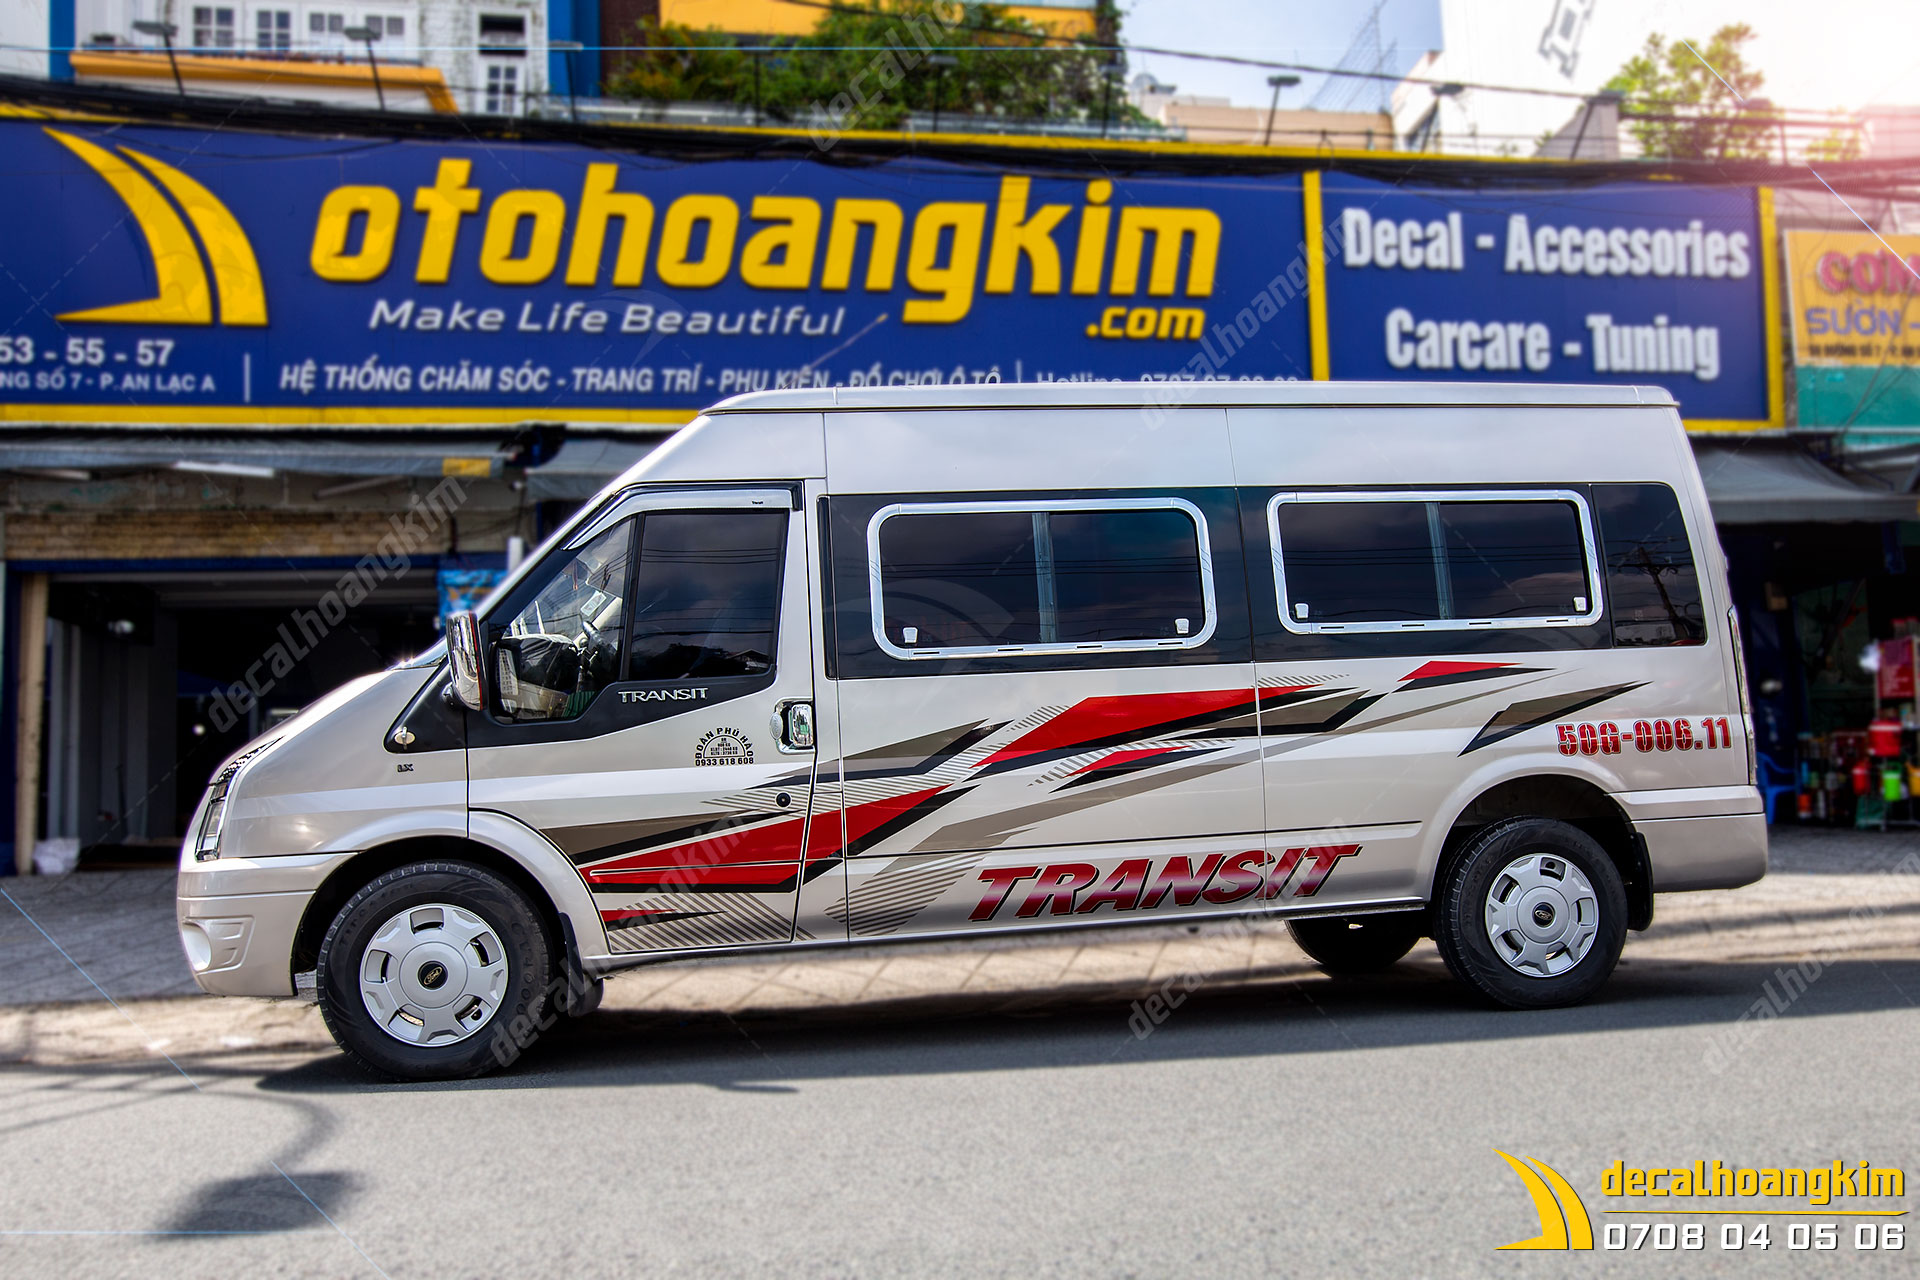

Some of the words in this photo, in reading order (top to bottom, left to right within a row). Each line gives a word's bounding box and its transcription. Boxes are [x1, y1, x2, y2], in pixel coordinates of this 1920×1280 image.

[309, 157, 1222, 324] otohoangkim
[1341, 207, 1464, 270] Decal
[1504, 214, 1752, 279] Accessories
[369, 299, 504, 331] Make
[517, 301, 608, 334] Life
[620, 304, 845, 335] Beautiful
[1086, 306, 1205, 339] .com
[66, 337, 105, 366] 55
[136, 339, 175, 367] 57
[1385, 308, 1551, 371] Carcare
[1586, 313, 1721, 381] Tuning
[70, 374, 83, 390] 7
[122, 374, 149, 391] AN
[156, 374, 196, 395] LẠC
[201, 375, 215, 392] A
[280, 357, 317, 395] HỆ
[324, 353, 412, 391] THỐNG
[418, 361, 492, 391] CHĂM
[498, 360, 551, 392] SÓC
[572, 368, 654, 392] TRANG
[618, 687, 708, 703] TRANSIT
[695, 758, 718, 767] 0933
[719, 757, 736, 766] 618
[968, 844, 1364, 922] TRANSIT
